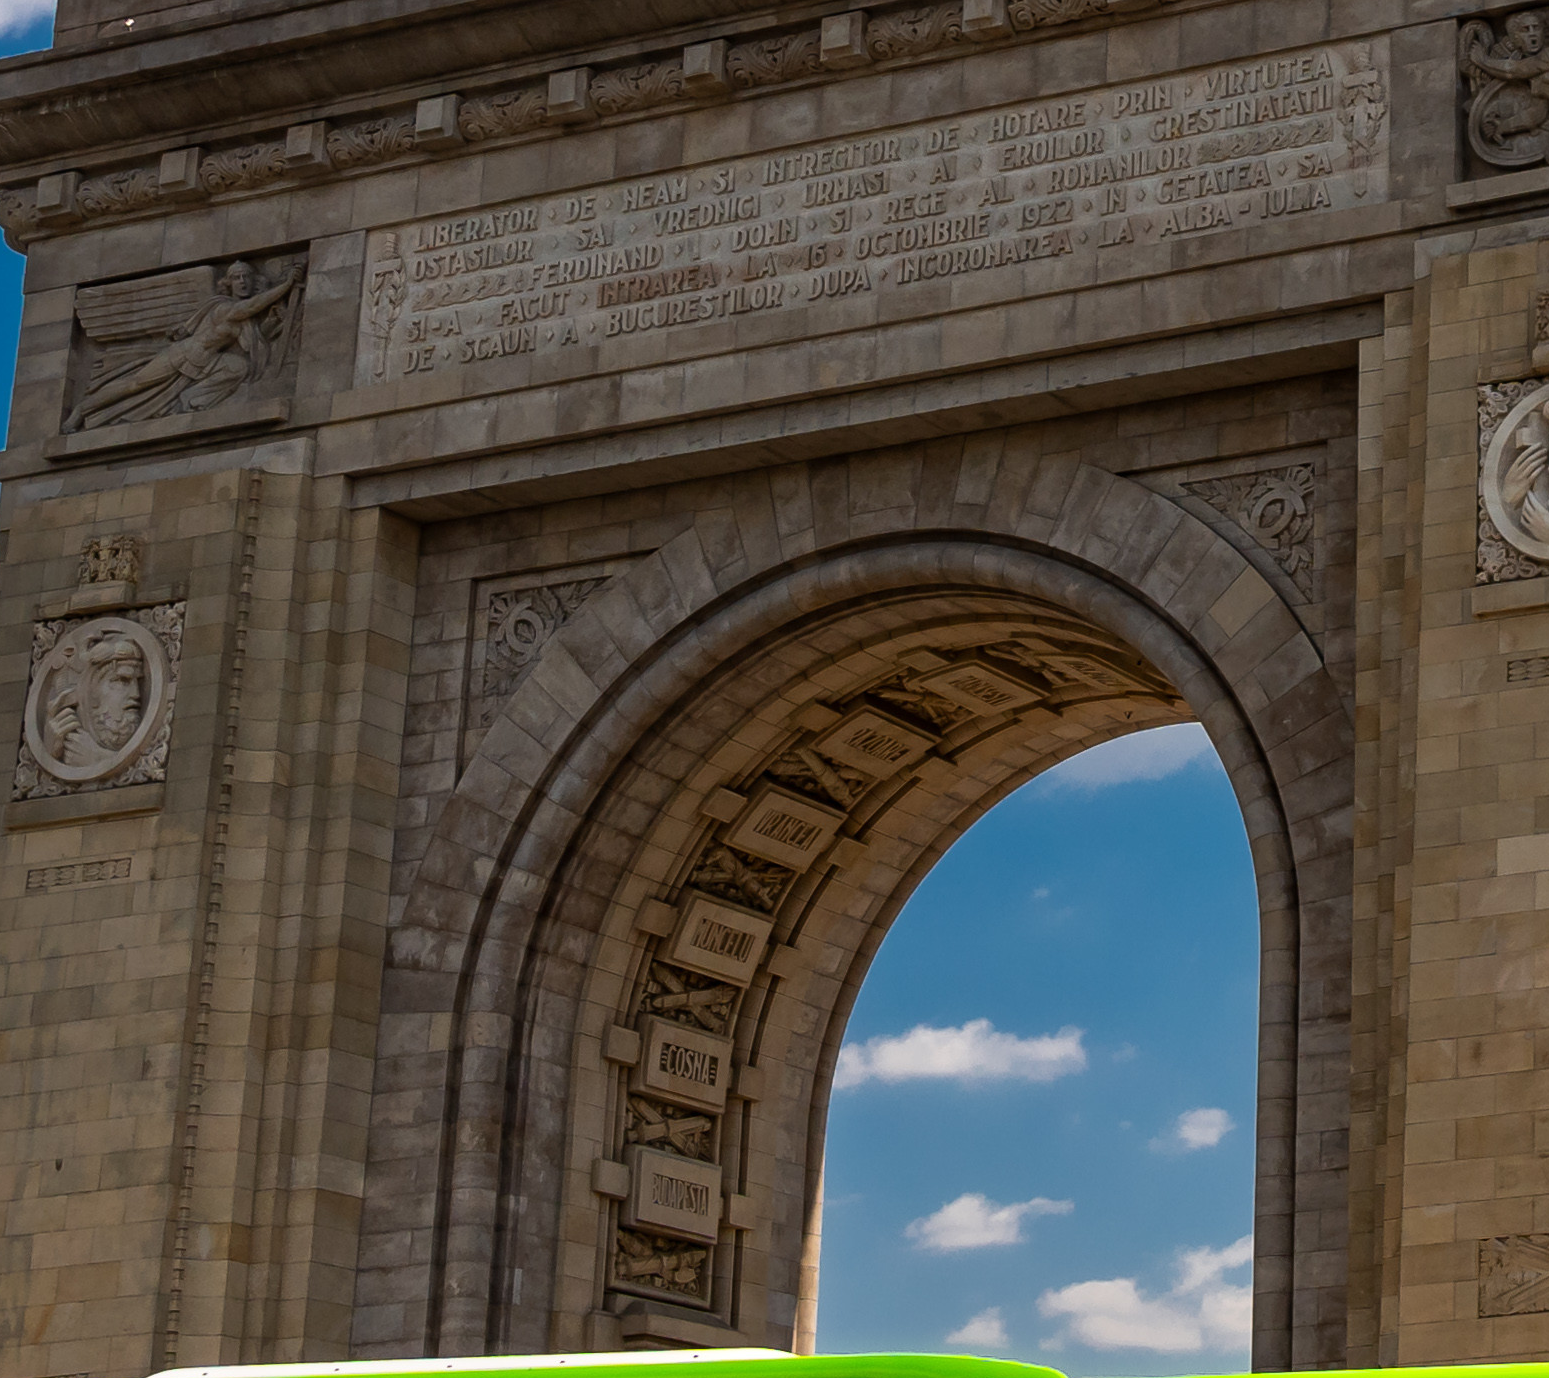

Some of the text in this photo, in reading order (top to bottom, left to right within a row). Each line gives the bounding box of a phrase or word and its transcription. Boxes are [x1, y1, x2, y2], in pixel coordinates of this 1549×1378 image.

[413, 52, 1334, 253] LIBERATOR DE NEAM SI INTREGITOR DE HOTARE PRIN VIRTUTEA
[414, 237, 533, 283] OSTASILOR
[653, 195, 761, 236] VREDNICI
[802, 174, 891, 208] URMASI
[929, 155, 957, 184] AI
[1000, 127, 1104, 172] EROILOR
[1150, 83, 1334, 142] CRESTINATATII
[530, 244, 664, 288] FERDINAND
[731, 217, 798, 252] DOMN
[829, 206, 852, 233] SI
[883, 190, 947, 224] REGE
[978, 179, 1014, 207] AL
[1047, 147, 1192, 195] ROMANILOR
[403, 346, 435, 373] DE
[459, 325, 537, 364] SCAUN
[560, 322, 578, 346] A
[606, 281, 782, 337] BUCURESTILOR
[807, 266, 871, 301] DUPA
[897, 228, 1073, 285] INCORONAREA
[1098, 220, 1134, 247] LA
[499, 290, 571, 327] FACUT
[598, 263, 718, 308] INTRAREA
[744, 252, 779, 281] LA
[803, 242, 827, 271] 16
[855, 211, 990, 260] OCTOMBRIE
[1018, 199, 1073, 232] 1922
[1101, 187, 1127, 216] IN
[1155, 159, 1271, 205] CETATEA
[1299, 151, 1333, 179] SA
[843, 728, 910, 762] RAZOARE
[753, 809, 823, 851] VRANCEA
[690, 916, 756, 963] MUNCELU
[652, 1174, 710, 1217] BUDAPESTA
